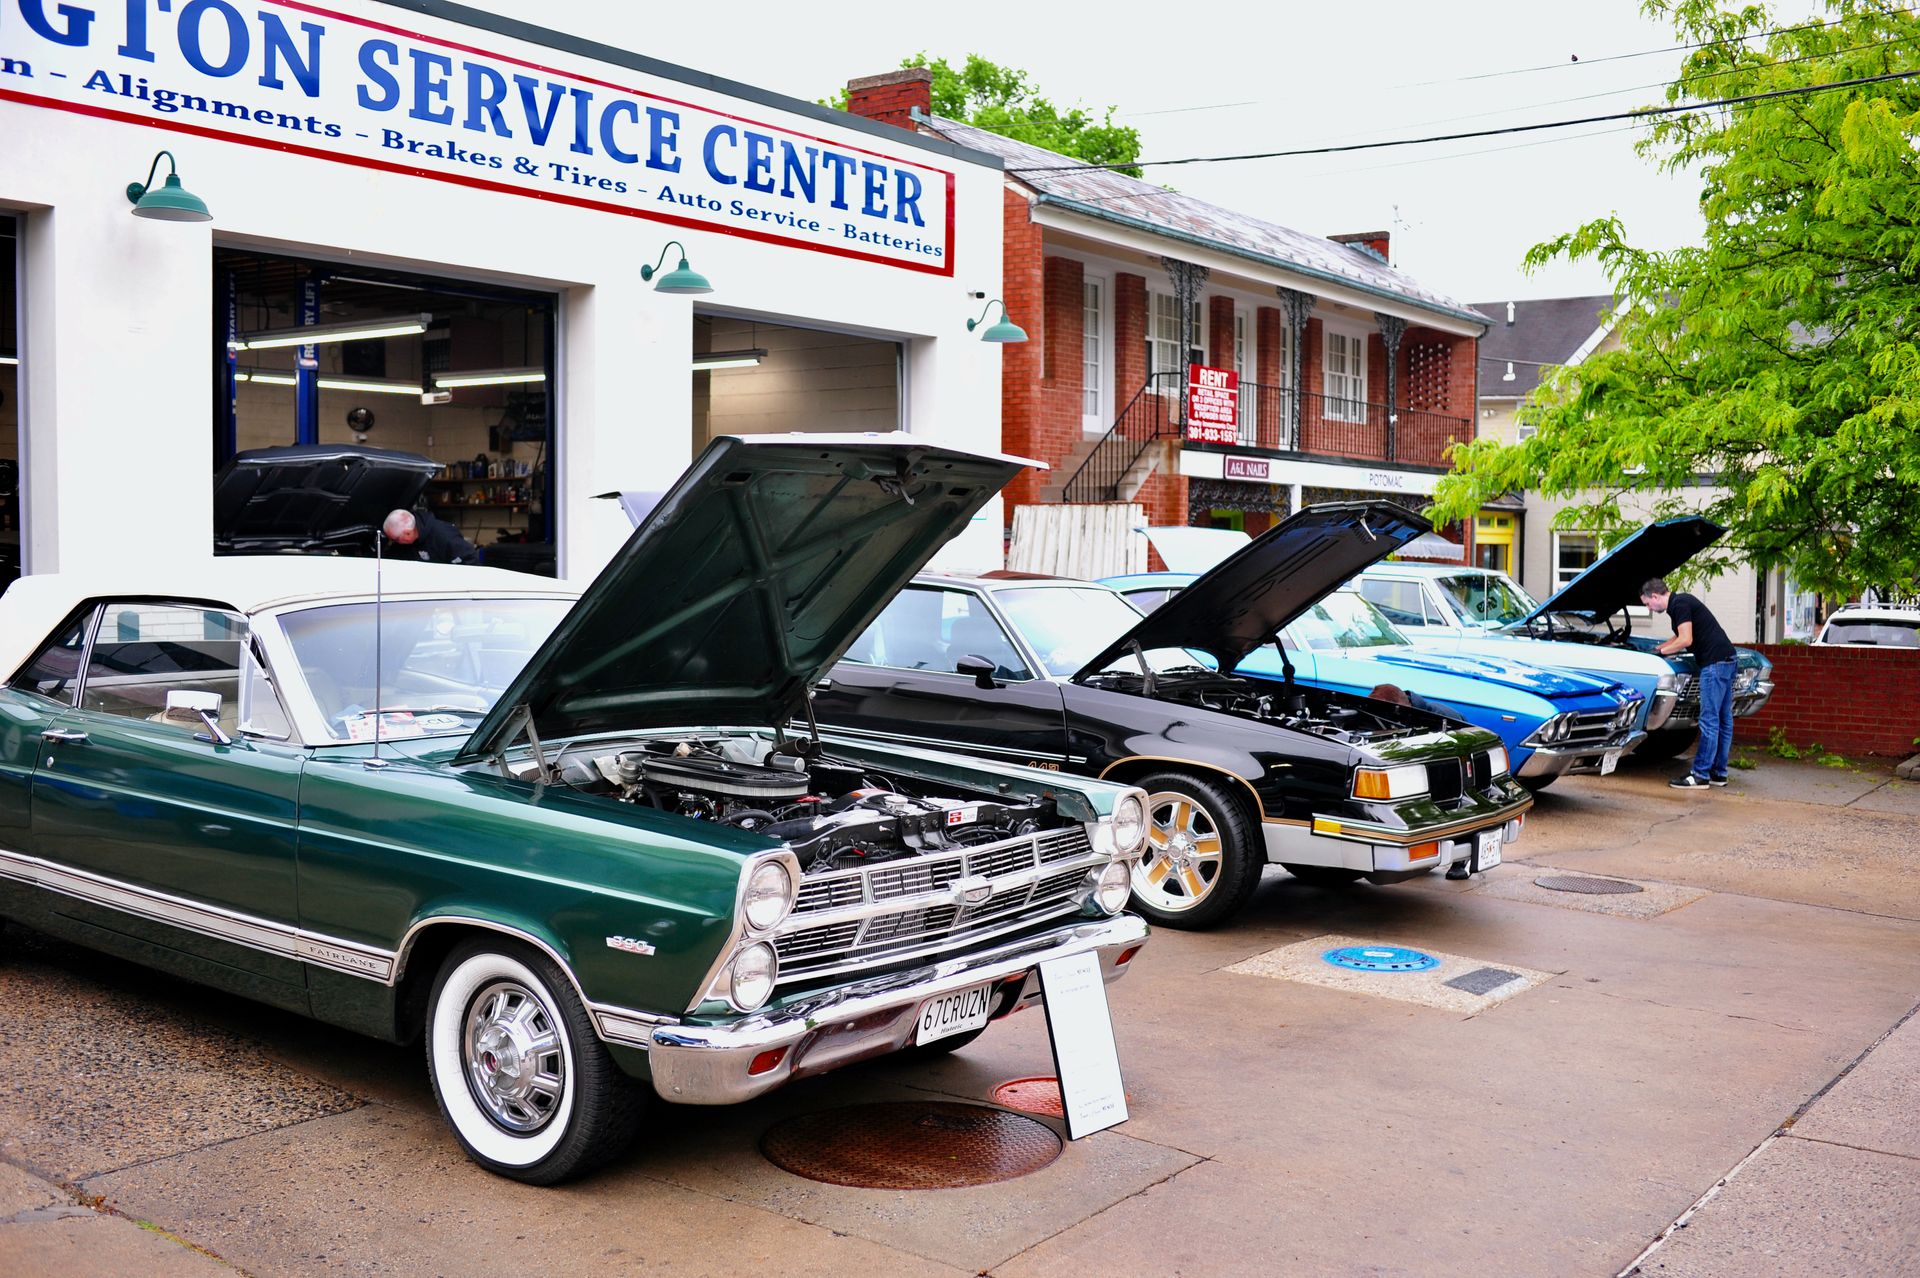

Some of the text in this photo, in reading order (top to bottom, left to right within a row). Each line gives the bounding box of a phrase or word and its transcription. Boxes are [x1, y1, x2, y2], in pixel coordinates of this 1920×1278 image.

[18, 0, 925, 227] GTON SERVICE CENTER
[82, 69, 342, 138] Alignments
[381, 128, 504, 170] Brakes
[513, 156, 539, 177] &
[547, 162, 628, 193] Tires
[657, 185, 723, 212] Auto
[729, 199, 821, 232] Service
[843, 223, 943, 257] Batteries
[304, 281, 315, 306] LIFT
[1200, 368, 1229, 388] RENT
[1231, 461, 1267, 477] A&L NAILS
[1369, 473, 1403, 488] POTOMAC
[309, 946, 377, 969] FAIRLANE
[924, 986, 989, 1031] 67CRUZN
